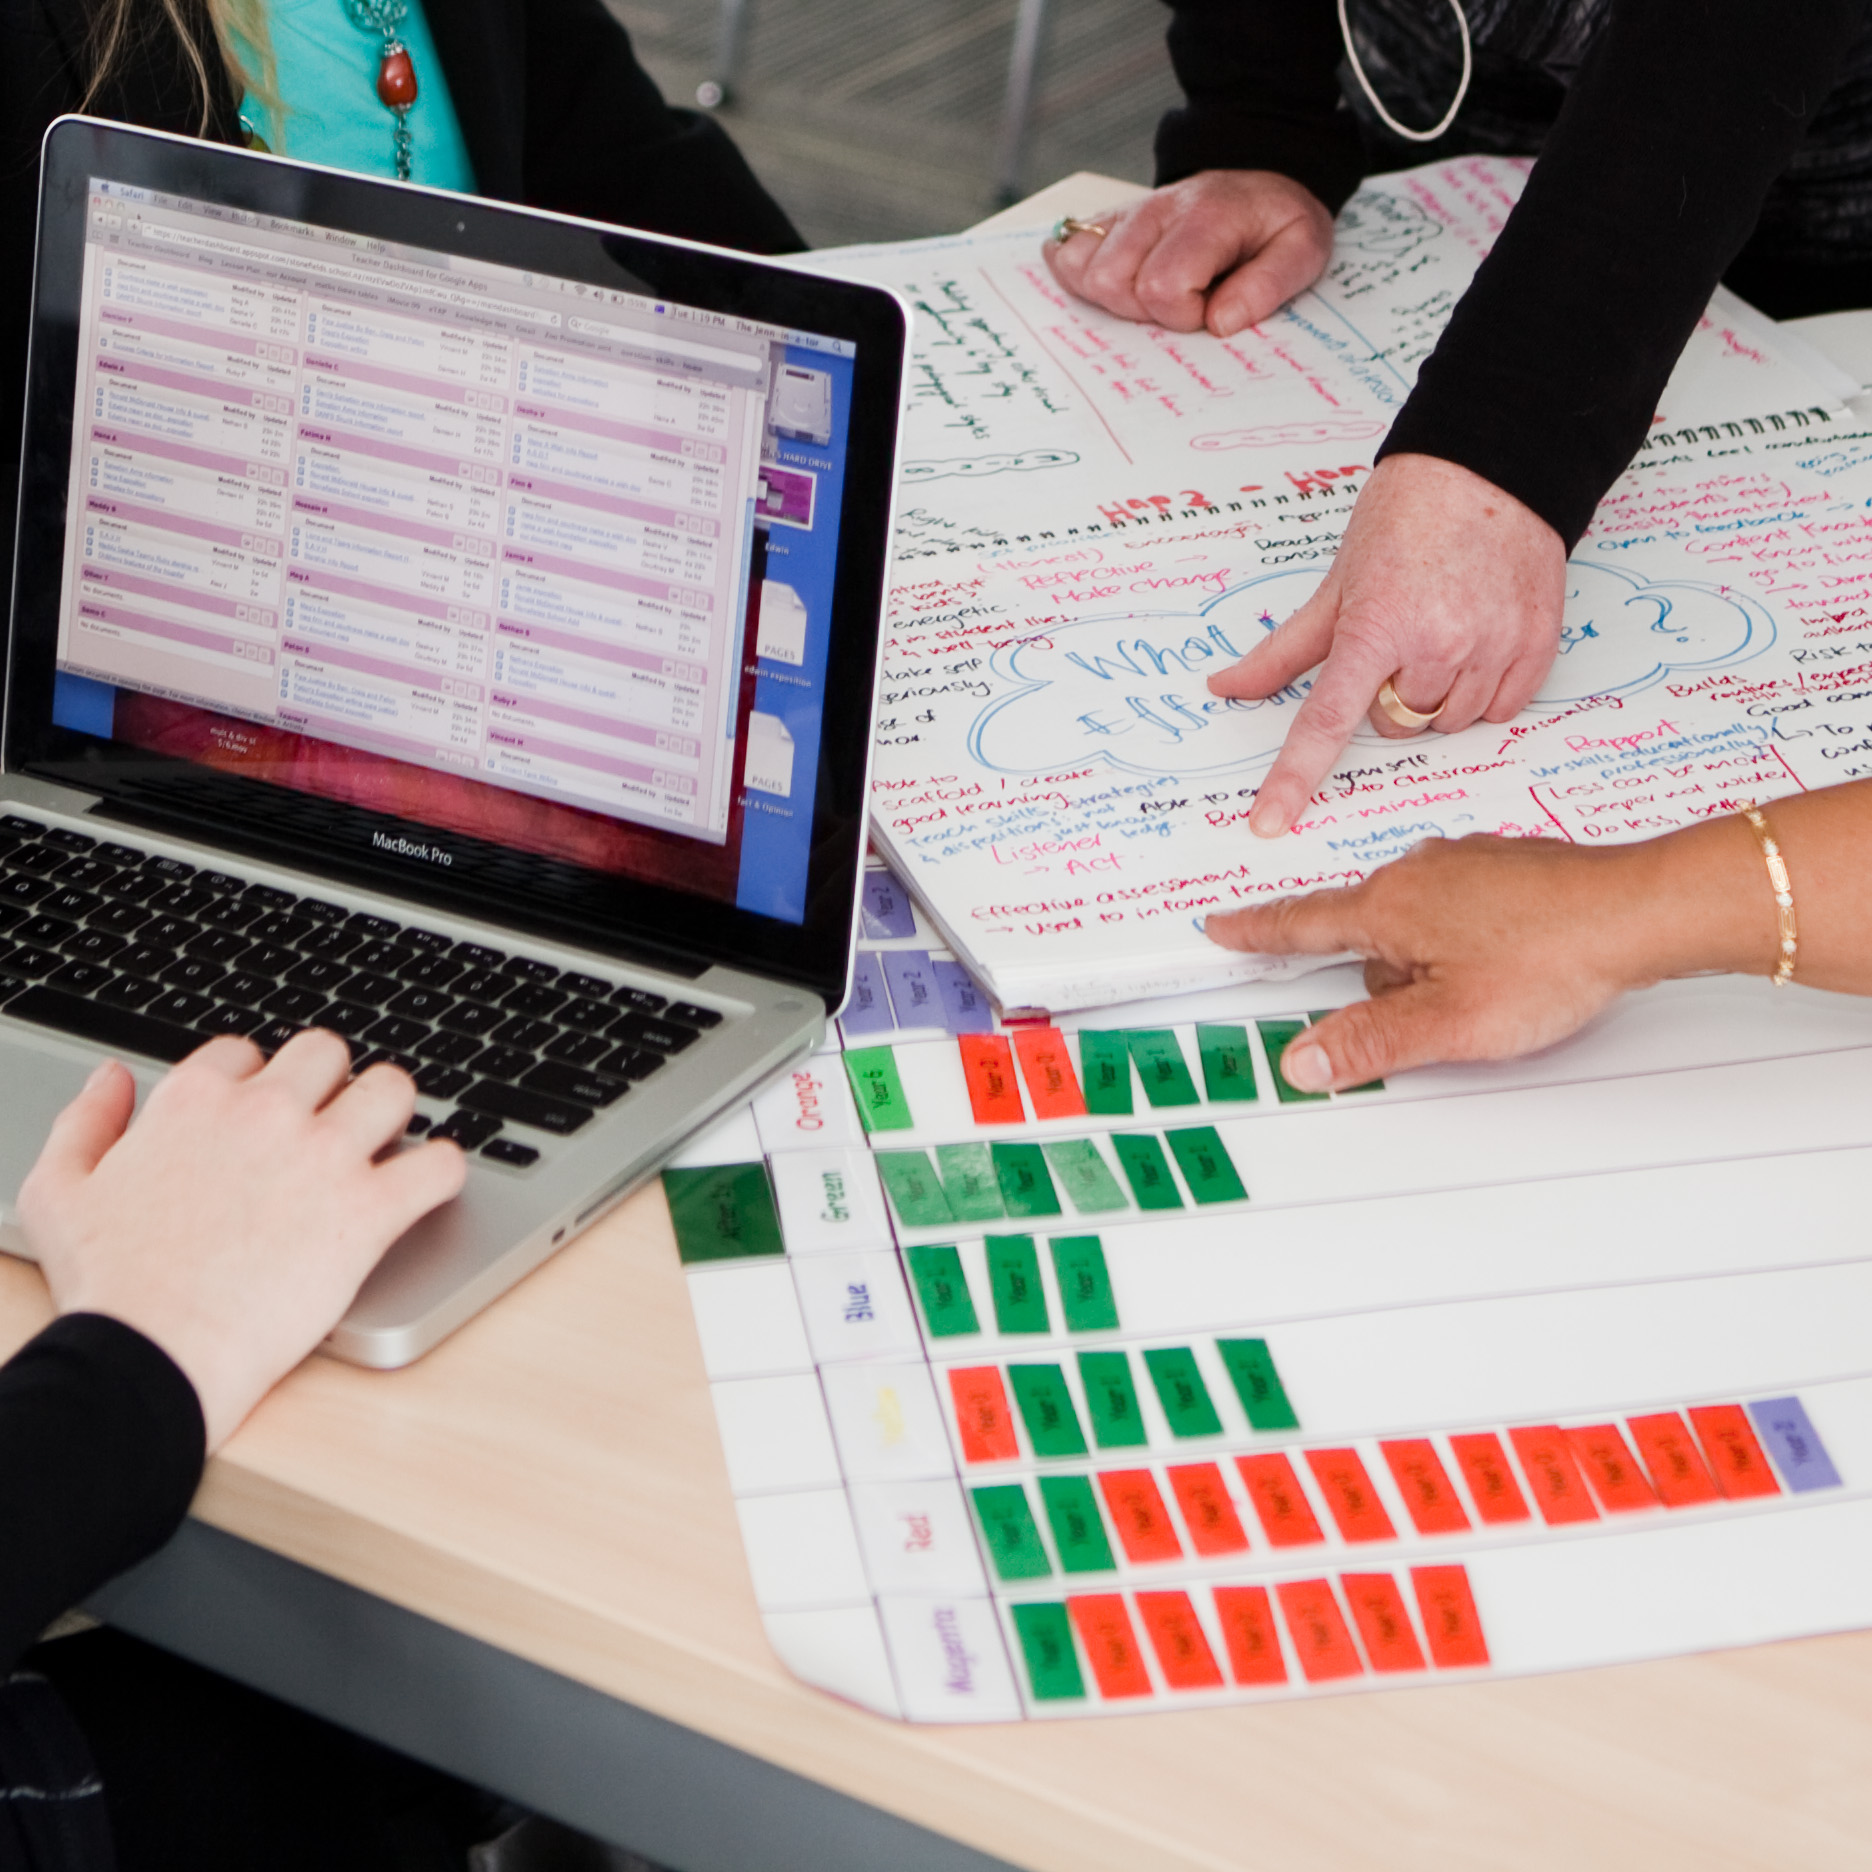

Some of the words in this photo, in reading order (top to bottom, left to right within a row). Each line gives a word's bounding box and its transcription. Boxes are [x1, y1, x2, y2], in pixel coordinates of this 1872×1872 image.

[120, 186, 145, 201] Safari
[325, 230, 357, 247] Window
[1684, 528, 1792, 554] Content
[1051, 584, 1121, 604] Make
[892, 604, 1008, 630] energetic
[764, 644, 796, 660] PAGES
[1063, 624, 1244, 681] What
[1789, 644, 1853, 666] Risk
[1509, 692, 1624, 738] Personality
[1746, 698, 1815, 718] Good
[1564, 718, 1681, 753] Rapport
[1816, 723, 1854, 737] To
[752, 775, 783, 792] PAGES
[871, 777, 918, 793] Able
[926, 773, 959, 786] to
[1549, 781, 1605, 801] Less
[1612, 773, 1660, 790] can
[1663, 763, 1695, 779] be
[1703, 752, 1778, 771] more
[1139, 796, 1194, 815] Able
[1197, 789, 1230, 805] to
[1574, 793, 1655, 819] Deeper
[1664, 784, 1705, 799] not
[892, 809, 949, 835] good
[1326, 820, 1446, 852] Modelling
[1582, 823, 1620, 839] Do
[372, 831, 429, 860] MacBook
[431, 847, 453, 867] Pro
[990, 832, 1102, 866] Listener
[1065, 851, 1126, 876] Act
[1024, 917, 1084, 937] Used
[1098, 908, 1124, 923] to
[795, 1071, 824, 1131] Orange
[871, 1080, 893, 1110] Year
[821, 1170, 850, 1224] Green
[844, 1282, 874, 1325] Blue
